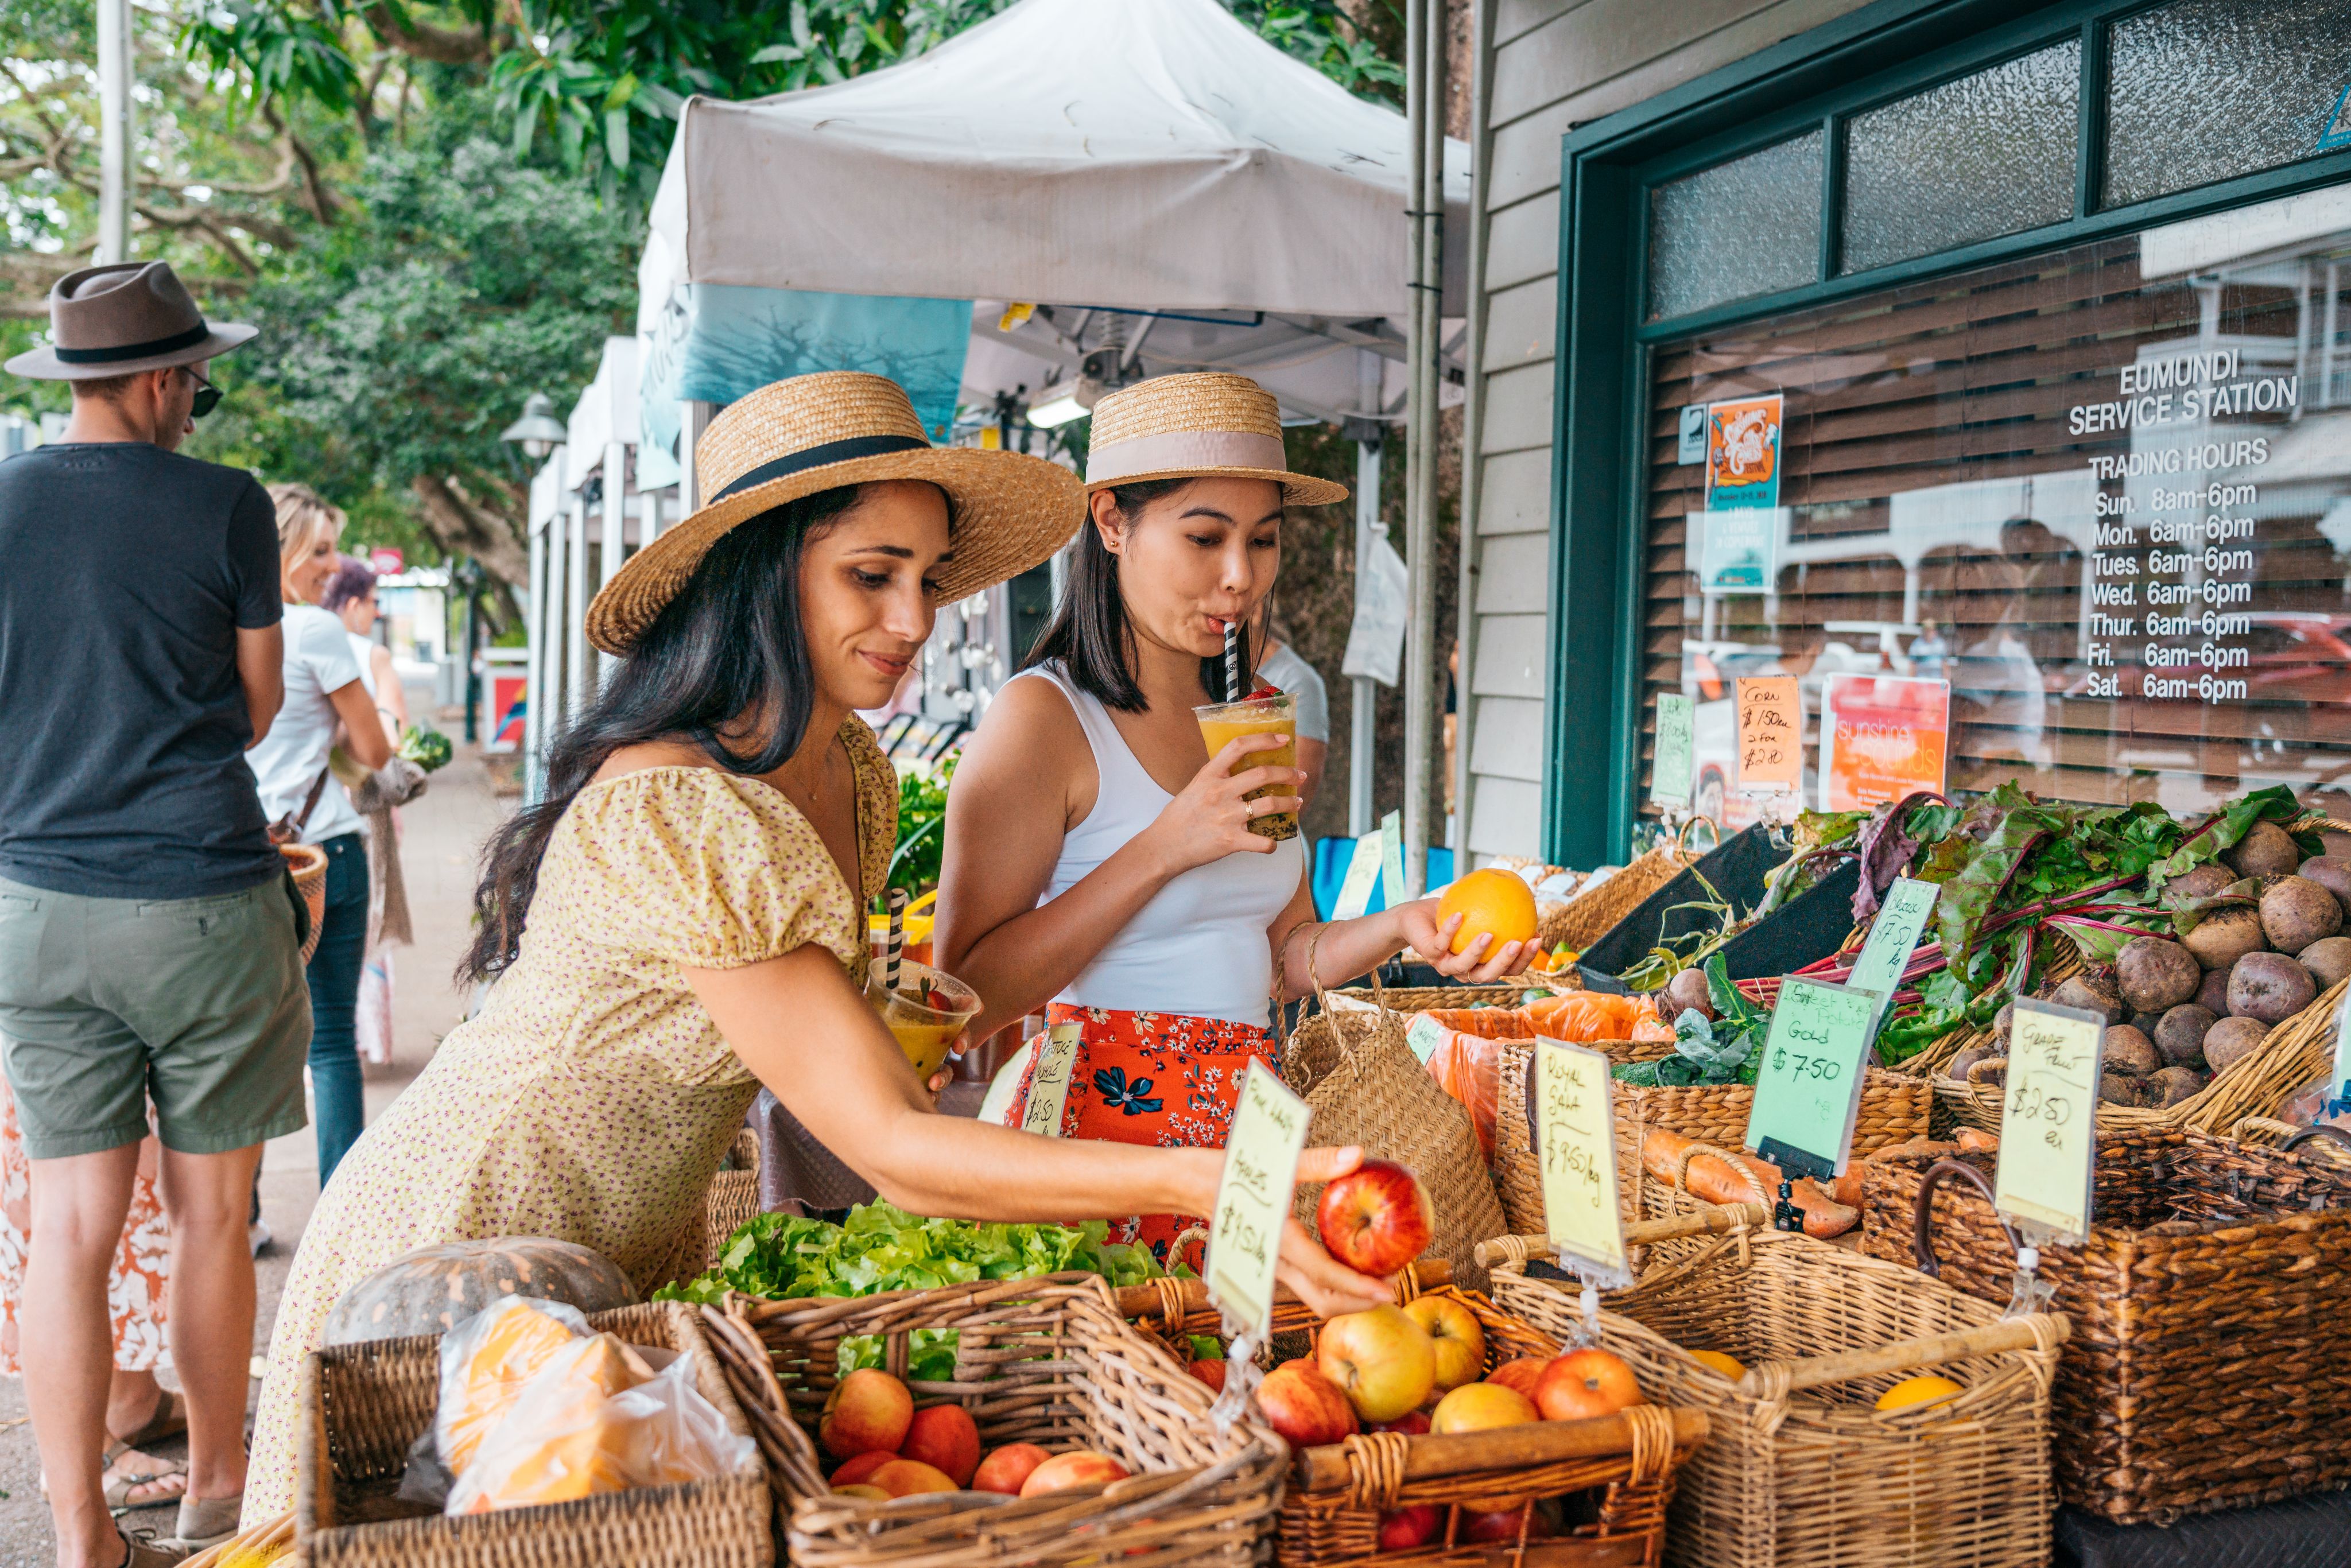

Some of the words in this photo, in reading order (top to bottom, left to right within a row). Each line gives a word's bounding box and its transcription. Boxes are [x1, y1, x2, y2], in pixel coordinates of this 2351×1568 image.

[2120, 348, 2239, 395] EUMUNDI
[2069, 394, 2172, 436] SERVICE
[2182, 376, 2298, 421] STATION
[2089, 448, 2180, 481] TRADING
[2187, 437, 2268, 471] HOURS
[2094, 492, 2135, 517] Sun.
[2092, 522, 2137, 546] Mon.
[2150, 515, 2254, 547] 6am-6pm
[2092, 552, 2140, 576] Tues.
[2148, 545, 2252, 576] 6am-6pm
[2091, 584, 2137, 606] Wed.
[2147, 579, 2251, 608] 6am-6pm
[2090, 612, 2137, 636] Thur.
[2146, 610, 2249, 641] 6am-6pm
[2087, 644, 2114, 666] Fri.
[2144, 642, 2248, 672] 6am-6pm
[1745, 686, 1779, 701] CORN
[2087, 672, 2122, 697] Sat.
[2143, 673, 2247, 704] 6am-6pm
[1838, 718, 1910, 745] sunshine
[1860, 739, 1937, 775] sounds
[1887, 948, 1901, 977] kg
[1038, 1061, 1062, 1080] WHOLE
[1025, 1092, 1054, 1130] $2.50
